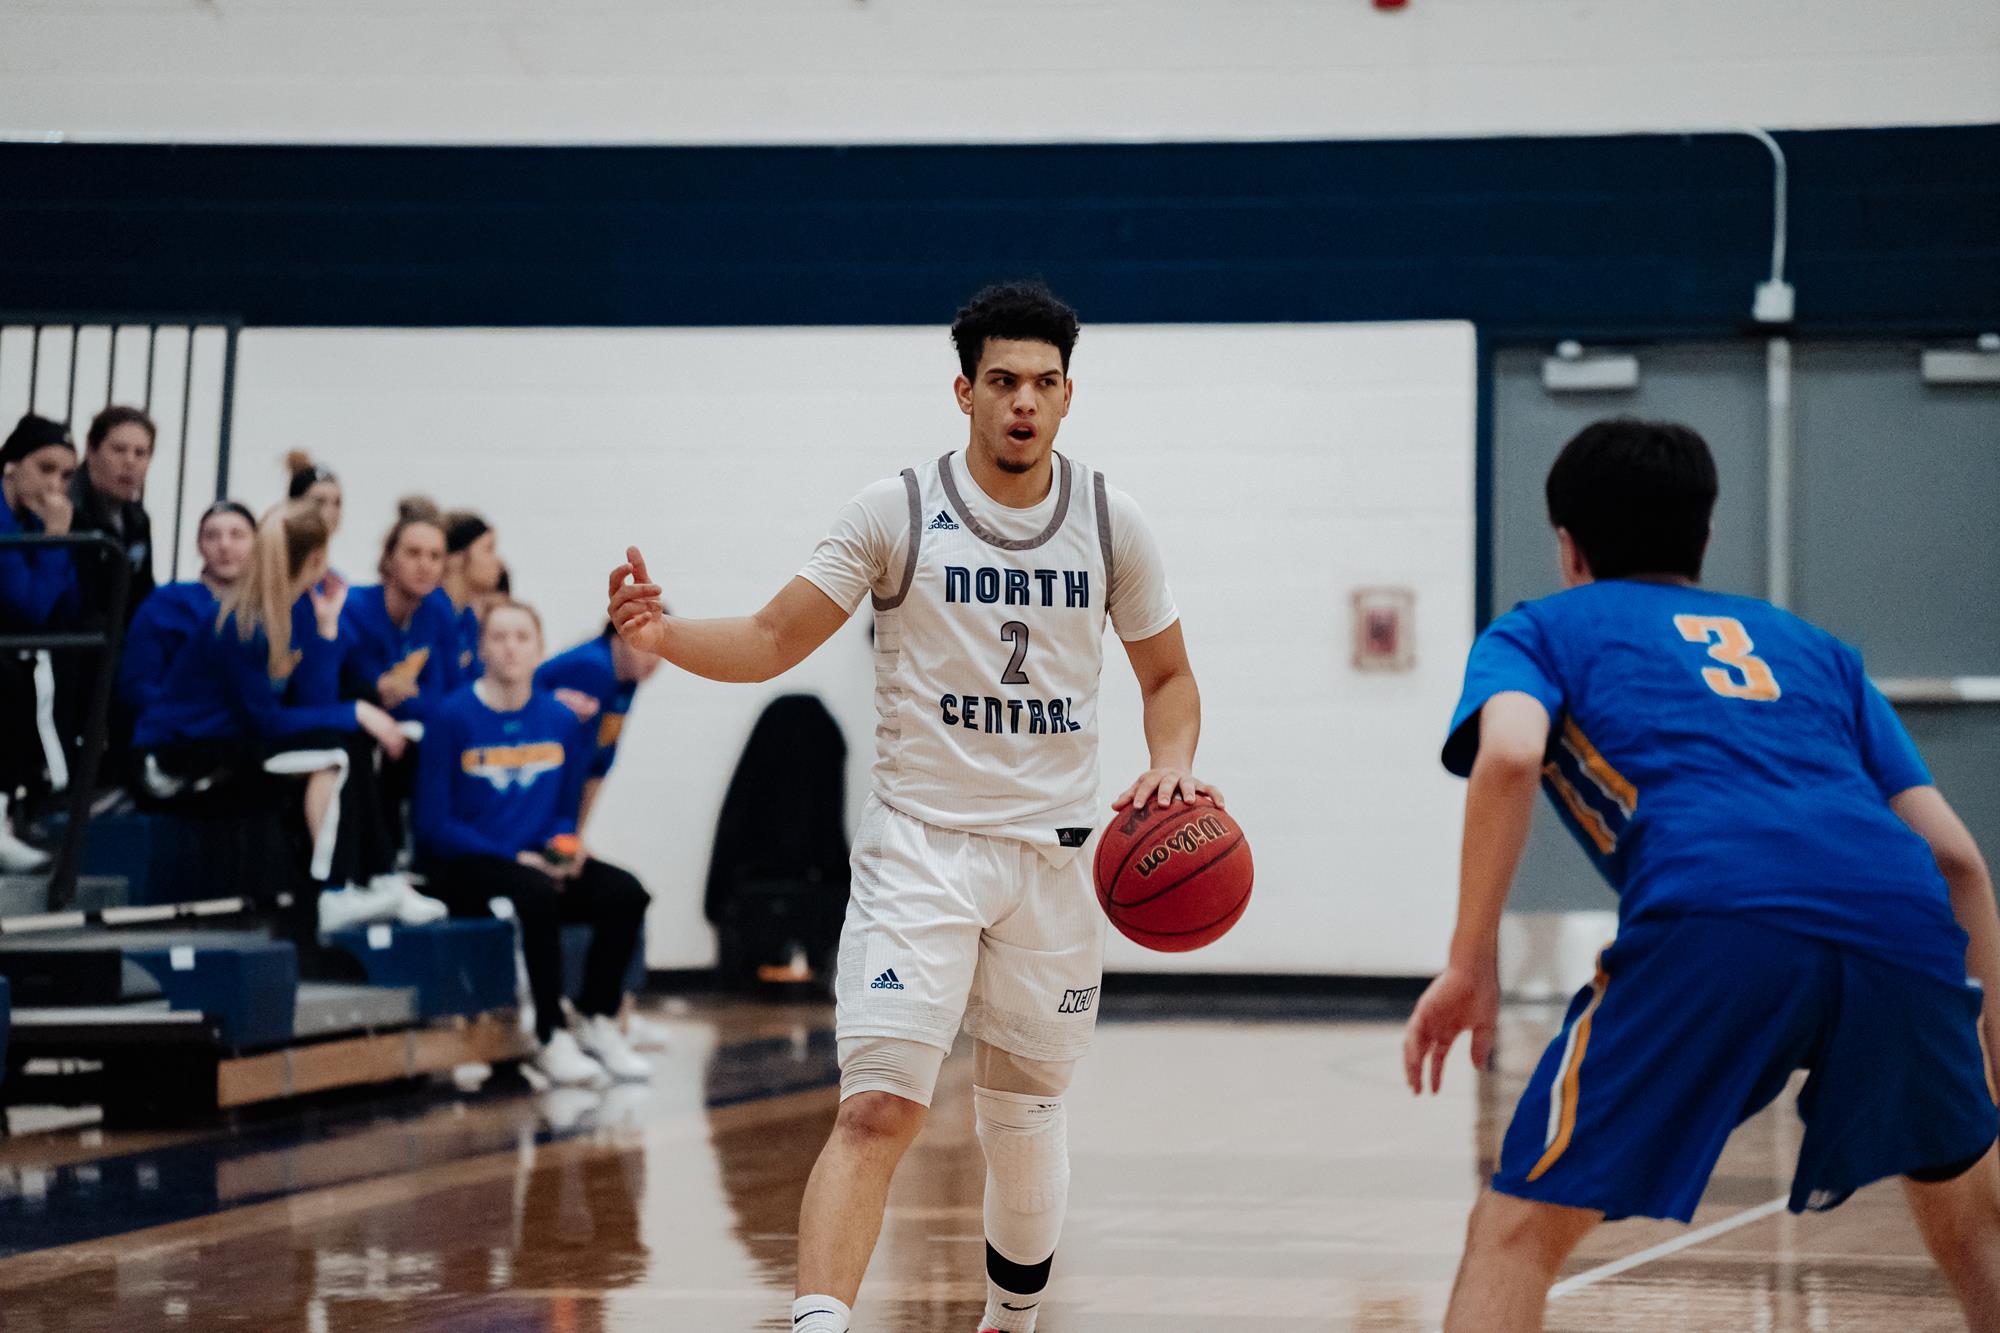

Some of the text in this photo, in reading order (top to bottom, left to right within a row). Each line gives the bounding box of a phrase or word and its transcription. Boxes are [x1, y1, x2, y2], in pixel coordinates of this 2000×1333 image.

[944, 565, 1089, 608] NORTH
[1000, 620, 1030, 684] 2
[1673, 614, 1781, 702] 3
[940, 693, 1081, 734] CENTRAL
[1134, 814, 1231, 877] Wilson
[870, 980, 905, 990] adidas
[1057, 985, 1098, 1013] NCU
